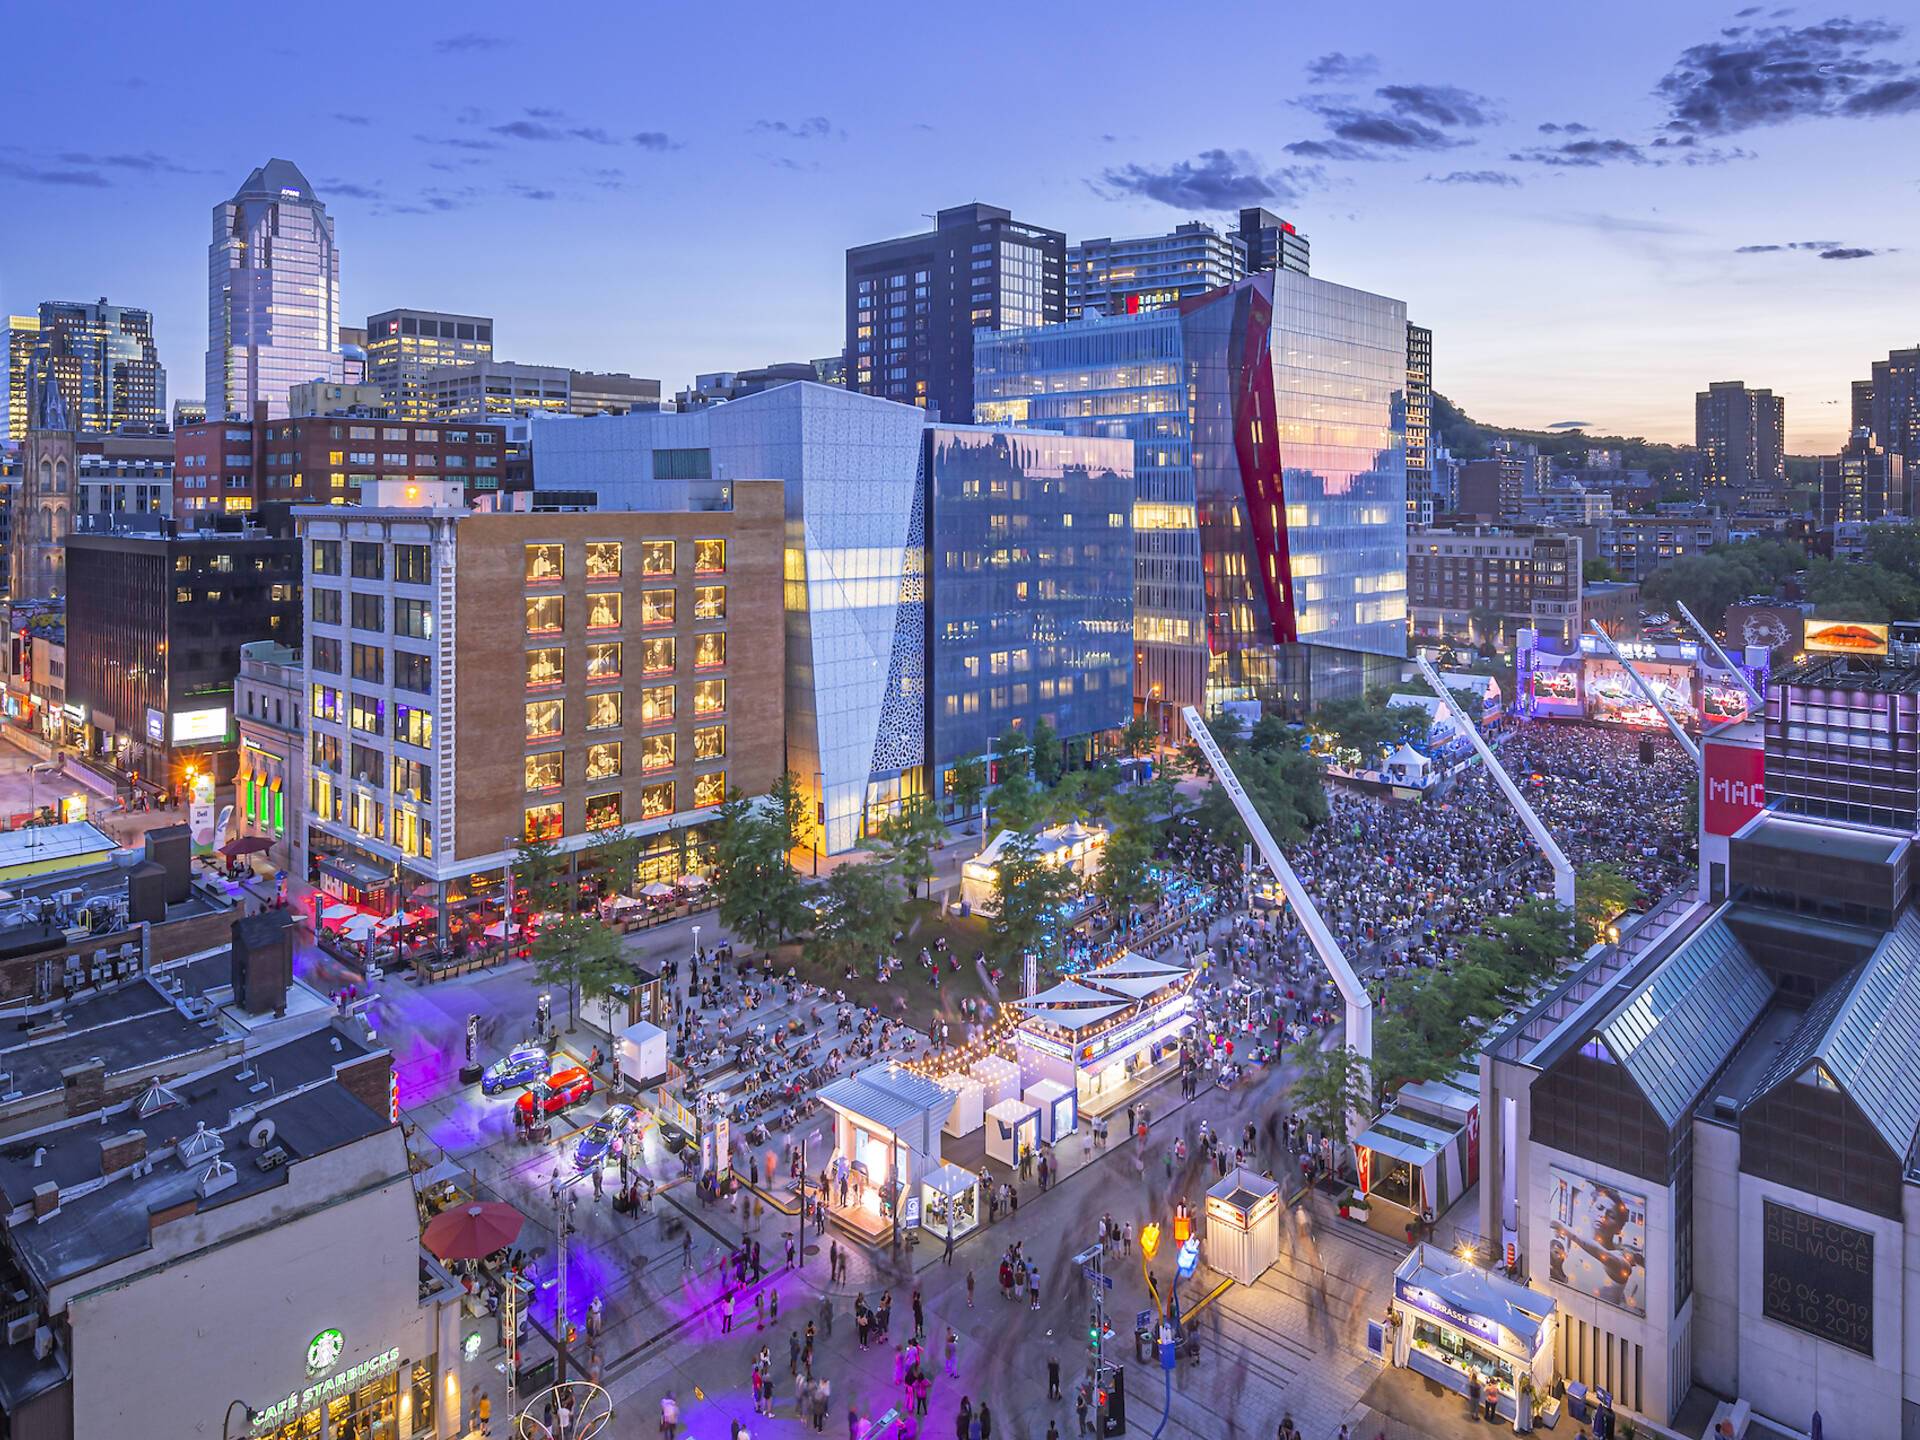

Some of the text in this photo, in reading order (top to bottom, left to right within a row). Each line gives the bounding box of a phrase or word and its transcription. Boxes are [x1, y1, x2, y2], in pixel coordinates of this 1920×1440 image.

[1709, 777, 1764, 808] MAC
[1767, 1204, 1869, 1254] REBECCA
[1767, 1224, 1869, 1274] BELMORE
[1427, 1299, 1467, 1324] TERRASSE
[1767, 1273, 1869, 1323] 20 06 2019
[1767, 1292, 1791, 1313] 06
[1798, 1303, 1820, 1323] 10
[1825, 1313, 1869, 1342] 2019
[252, 1346, 400, 1426] CAFÉ STARBUCKS
